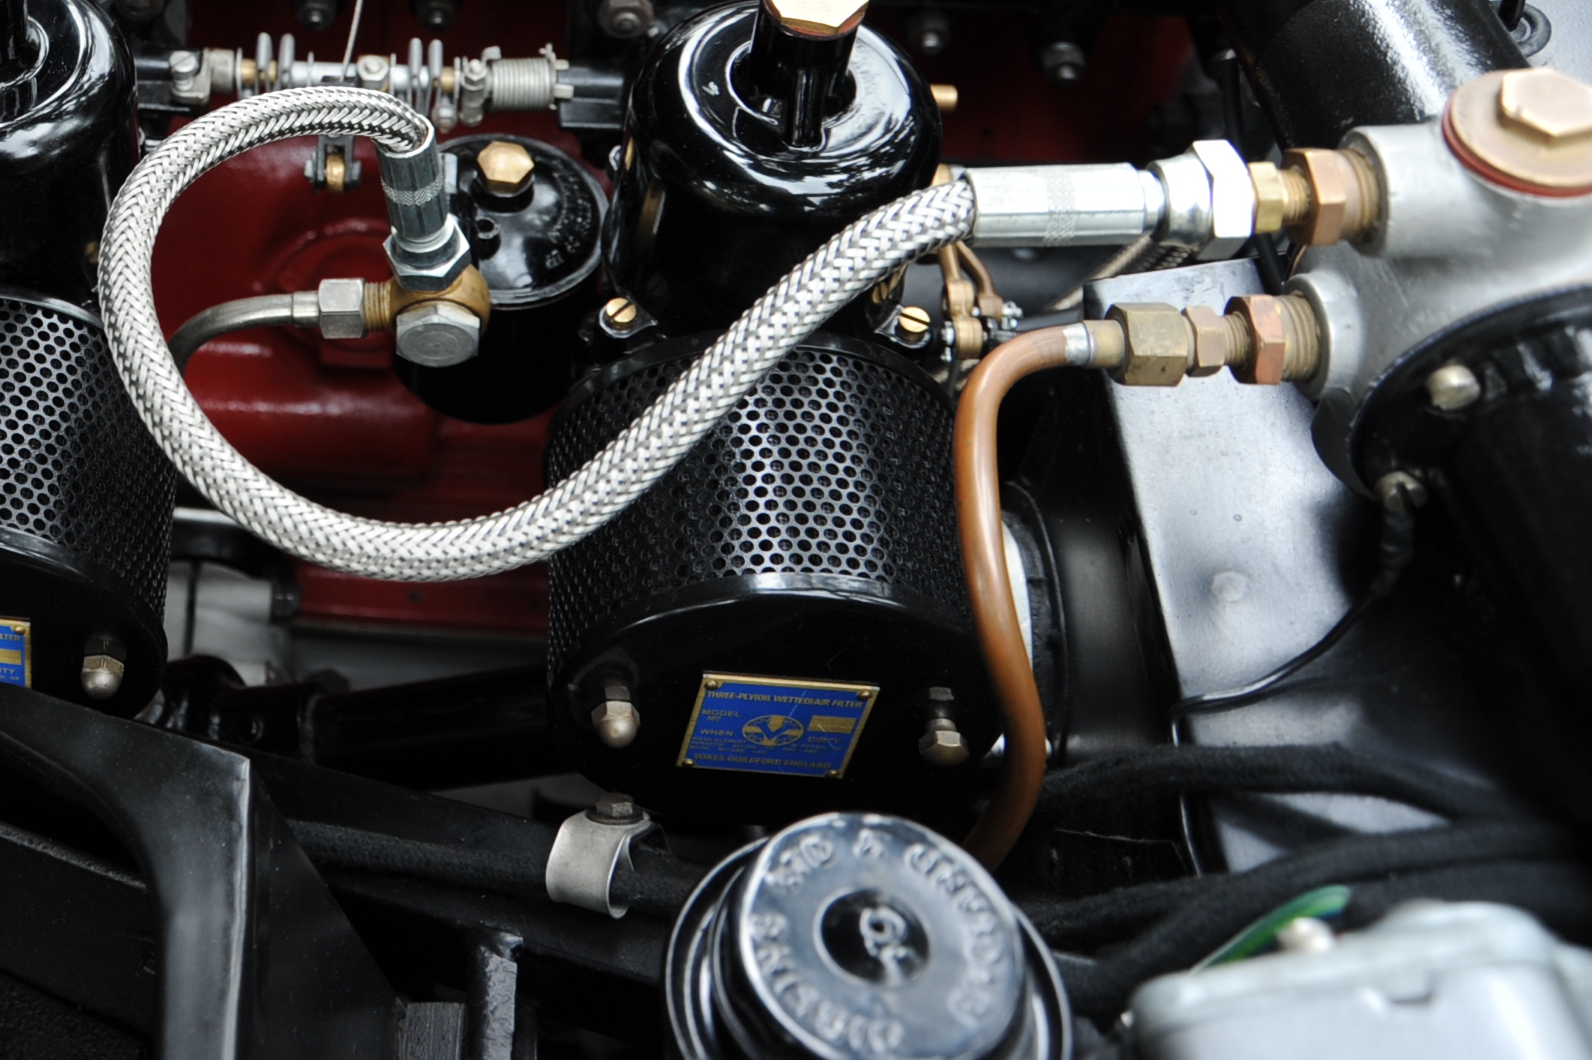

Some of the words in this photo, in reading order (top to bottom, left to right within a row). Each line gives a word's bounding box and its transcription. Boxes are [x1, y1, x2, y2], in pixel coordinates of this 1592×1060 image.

[831, 700, 864, 709] FILTER
[701, 708, 741, 717] MODEL
[700, 728, 734, 736] WHEN
[807, 736, 842, 745] DIRTY
[693, 753, 725, 762] VOKES
[727, 755, 782, 766] GUILDFORD
[783, 759, 831, 769] ENGLAND
